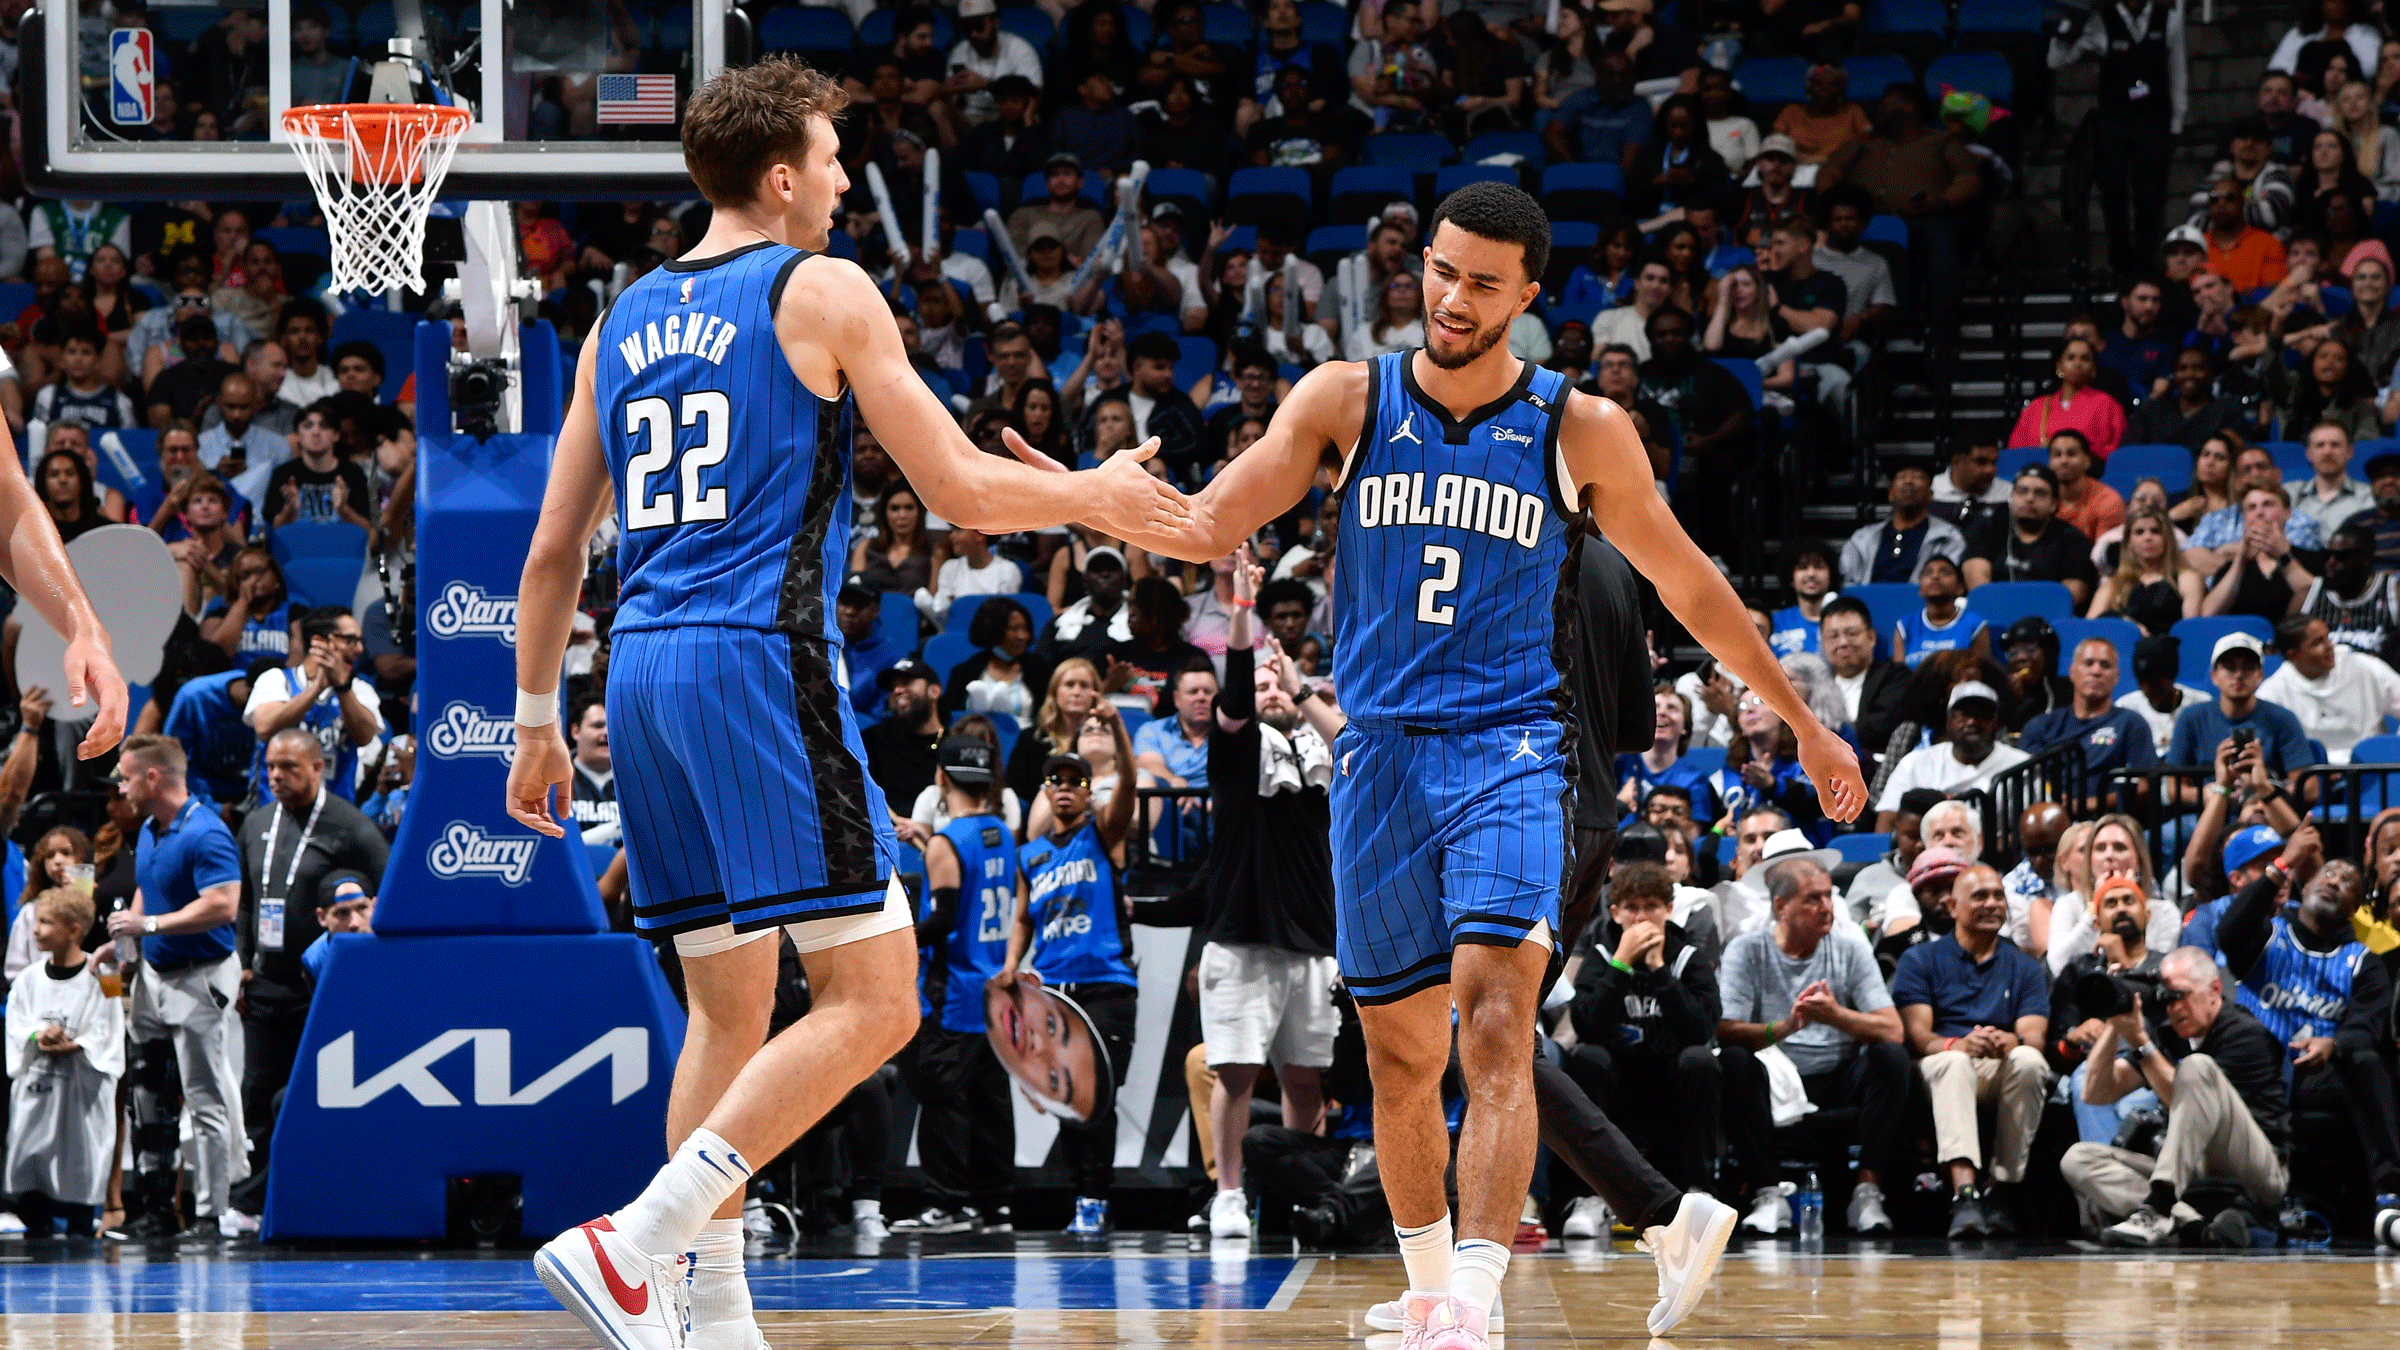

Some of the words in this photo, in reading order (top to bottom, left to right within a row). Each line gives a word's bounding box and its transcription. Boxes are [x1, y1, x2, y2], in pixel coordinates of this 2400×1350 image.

[117, 102, 139, 118] NBA
[618, 312, 738, 376] WAGNER
[1528, 394, 1547, 408] PW
[626, 389, 731, 532] 22
[1490, 425, 1534, 448] Disney
[1358, 471, 1546, 550] ORLANDO
[1416, 543, 1462, 627] 2
[431, 824, 535, 883] Starry
[317, 1026, 649, 1109] KIA
